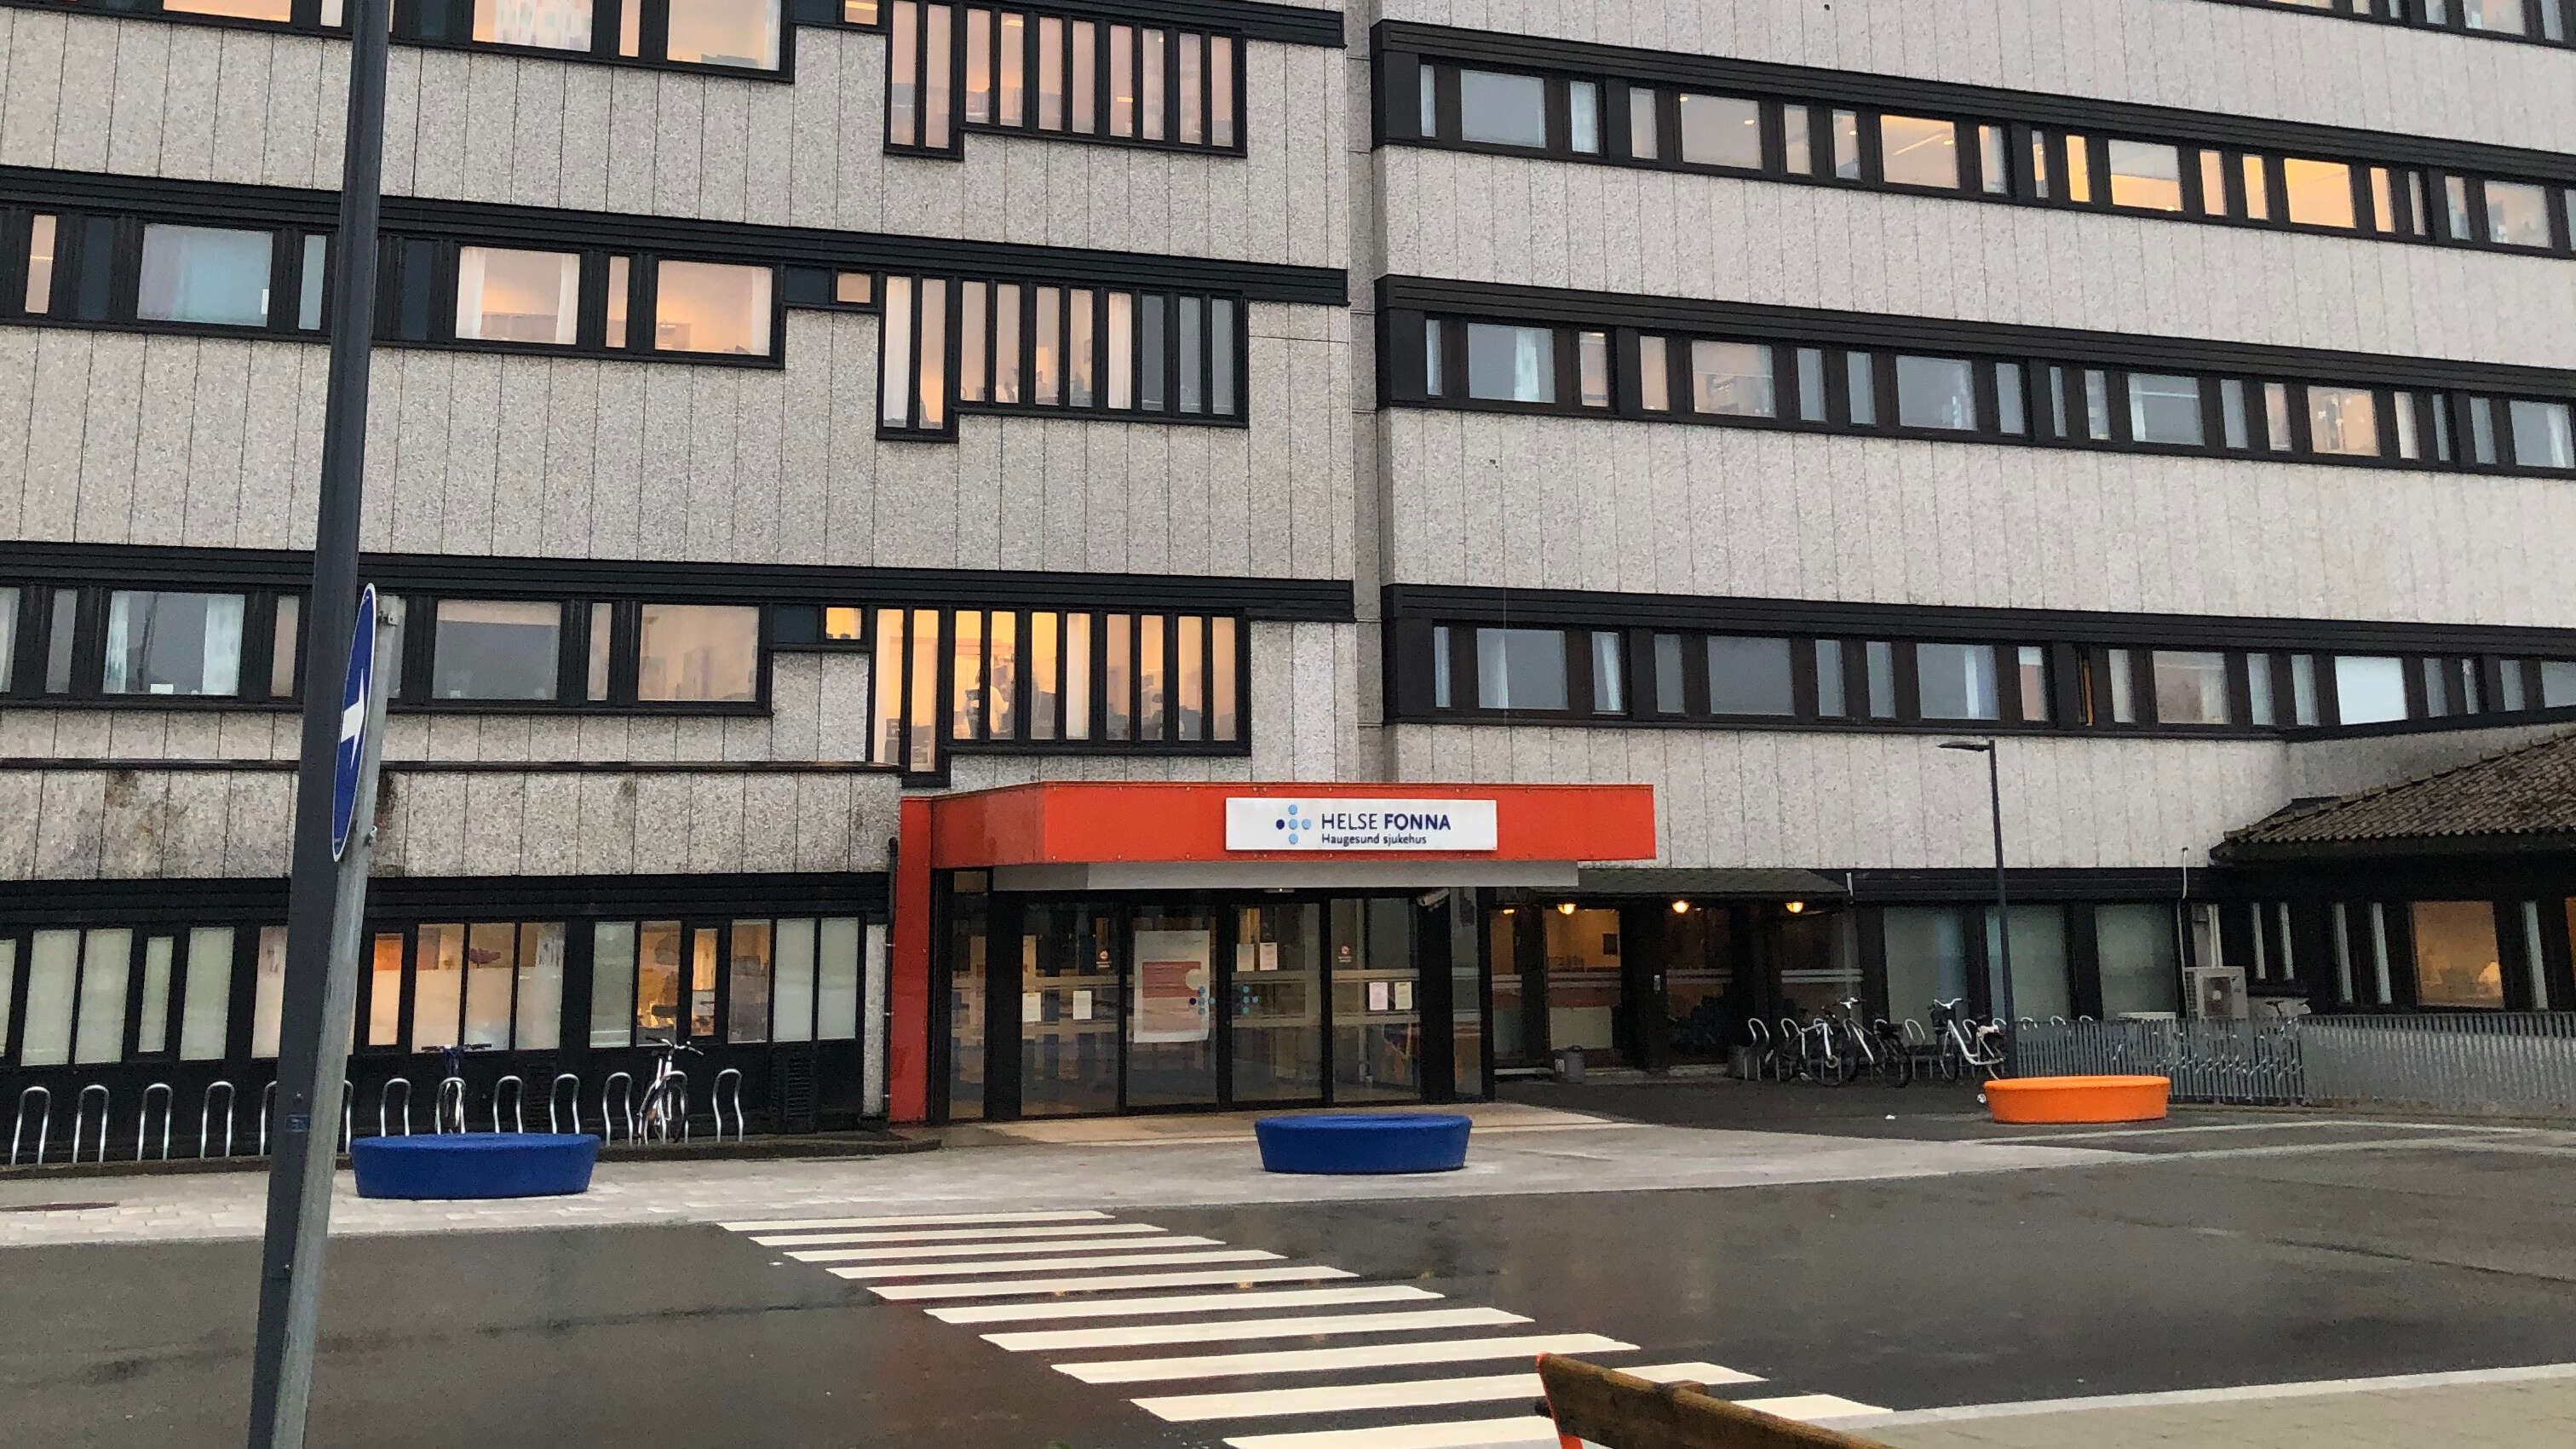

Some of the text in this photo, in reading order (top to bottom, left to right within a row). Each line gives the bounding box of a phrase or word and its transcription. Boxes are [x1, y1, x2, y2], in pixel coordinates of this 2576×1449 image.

[1321, 813, 1451, 831] HELSE FONNA
[1321, 833, 1427, 847] Haugesund sjukehus
